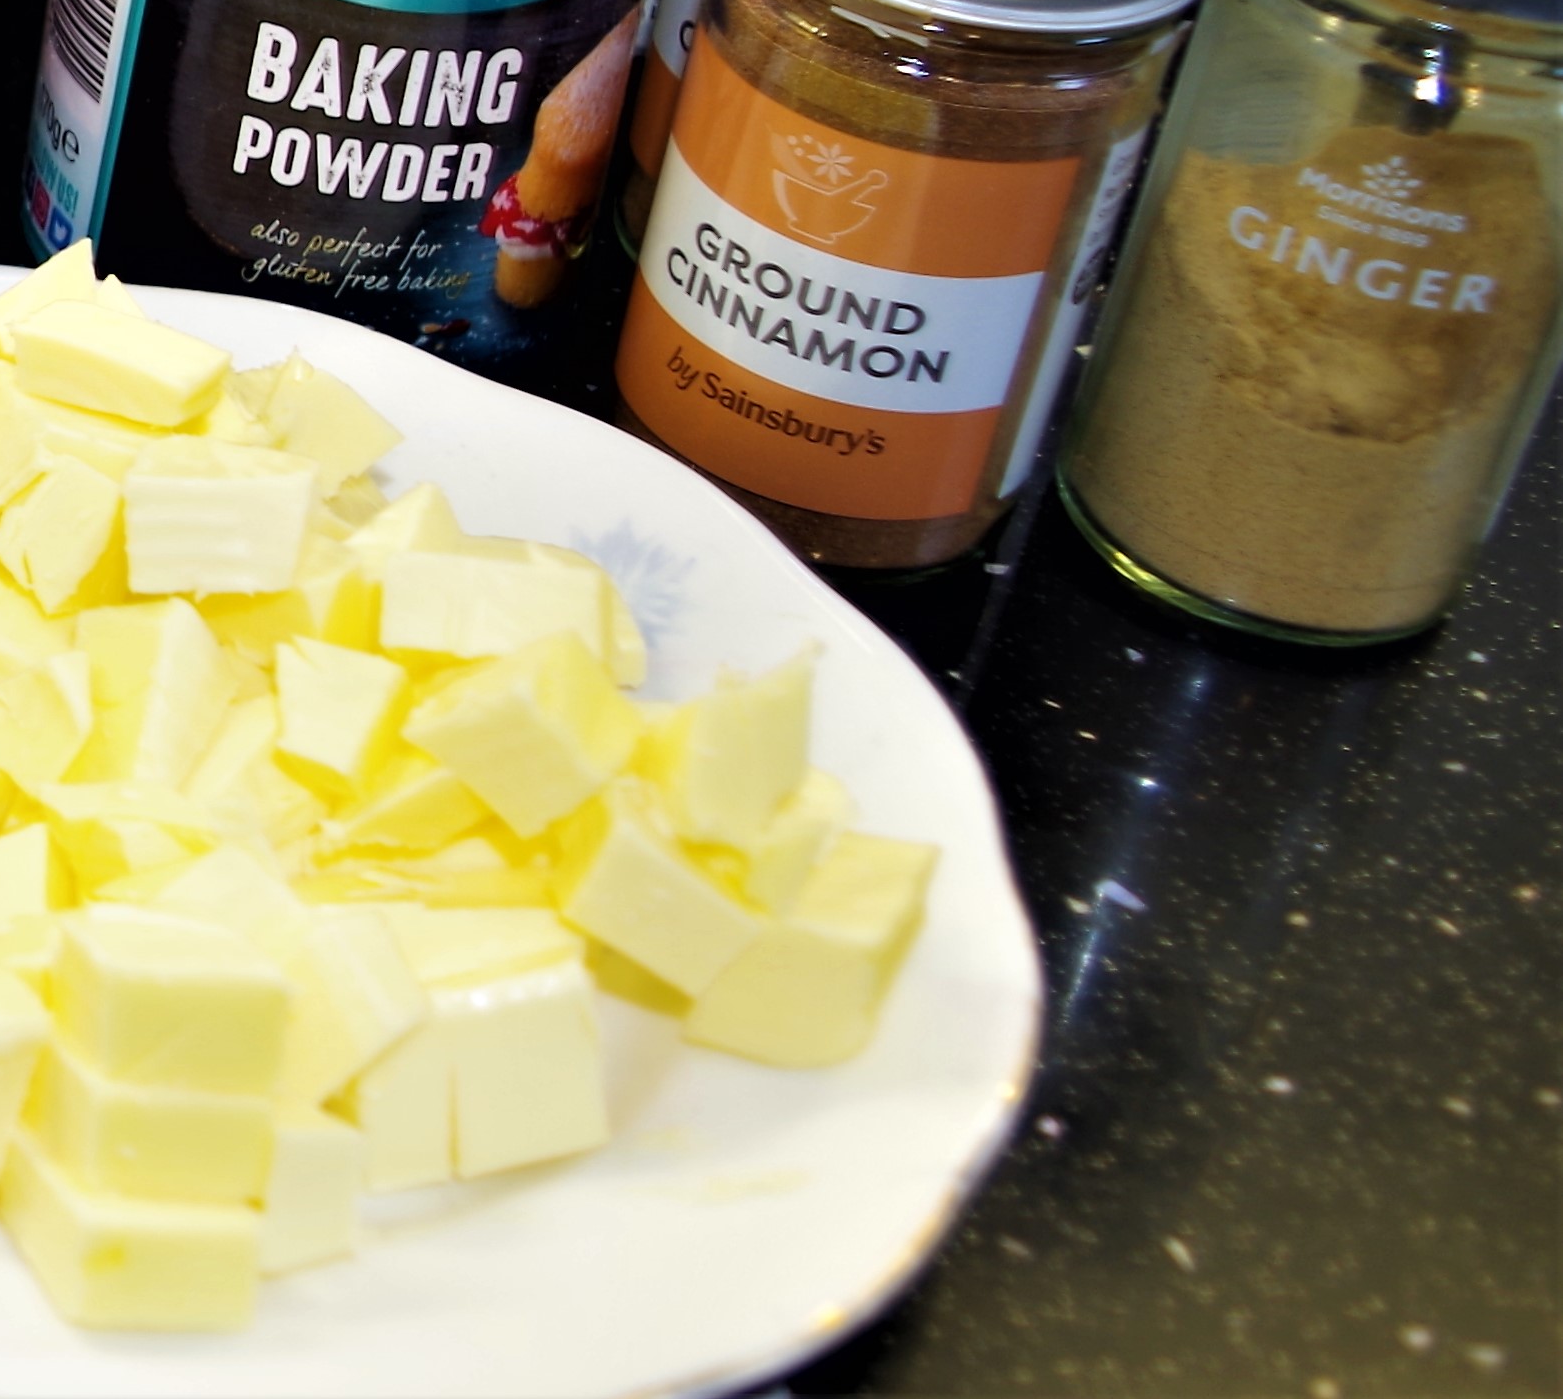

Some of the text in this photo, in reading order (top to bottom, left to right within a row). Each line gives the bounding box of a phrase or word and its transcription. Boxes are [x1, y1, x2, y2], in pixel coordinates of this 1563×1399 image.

[247, 20, 523, 128] BAKING
[233, 114, 493, 203] POWDER
[1297, 167, 1467, 232] Morrisons
[241, 257, 471, 298] gluten free baking
[250, 219, 443, 269] also perfect for
[695, 222, 926, 337] GROUND
[1229, 206, 1497, 313] GINGER
[667, 246, 950, 384] CINNAMON
[667, 346, 886, 456] by Sainsbury's
